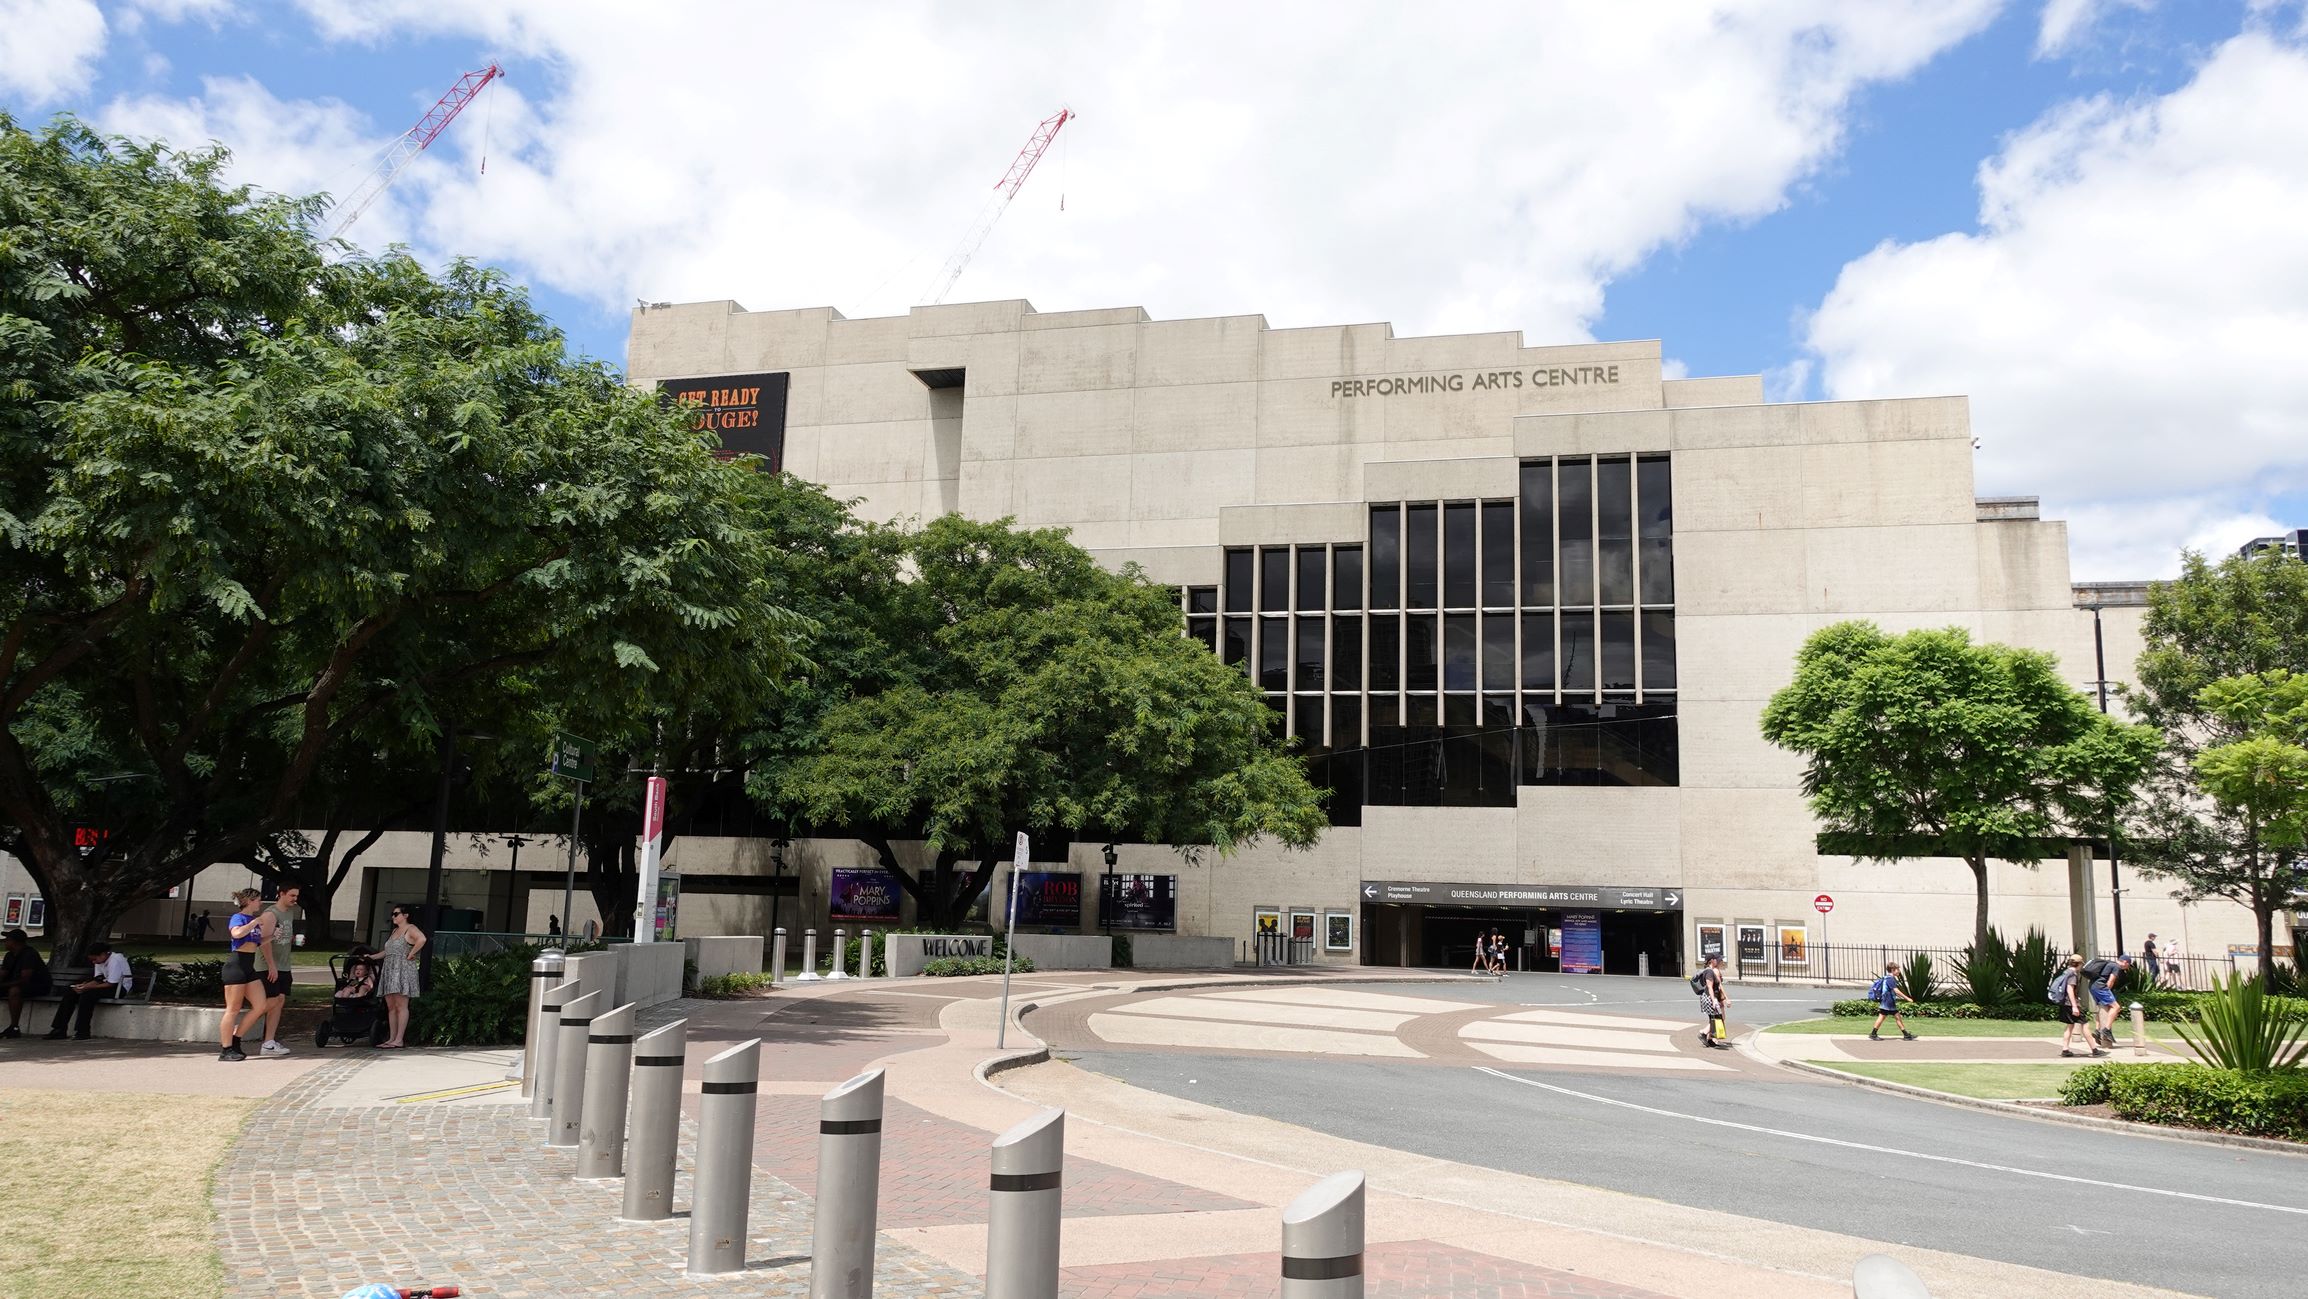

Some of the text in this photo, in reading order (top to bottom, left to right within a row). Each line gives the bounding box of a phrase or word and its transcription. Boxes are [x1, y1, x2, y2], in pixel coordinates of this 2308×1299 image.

[1331, 365, 1619, 398] PERFORMING ARTS CENTRE
[678, 387, 760, 408] GET READY
[562, 754, 578, 769] Centre
[859, 886, 886, 896] MARY
[1043, 880, 1078, 896] ROB
[1451, 890, 1598, 901] QUEENSLAND PERFORMING ARTS CENTRE
[853, 895, 891, 906] POPPINS
[922, 938, 989, 957] WELCOME
